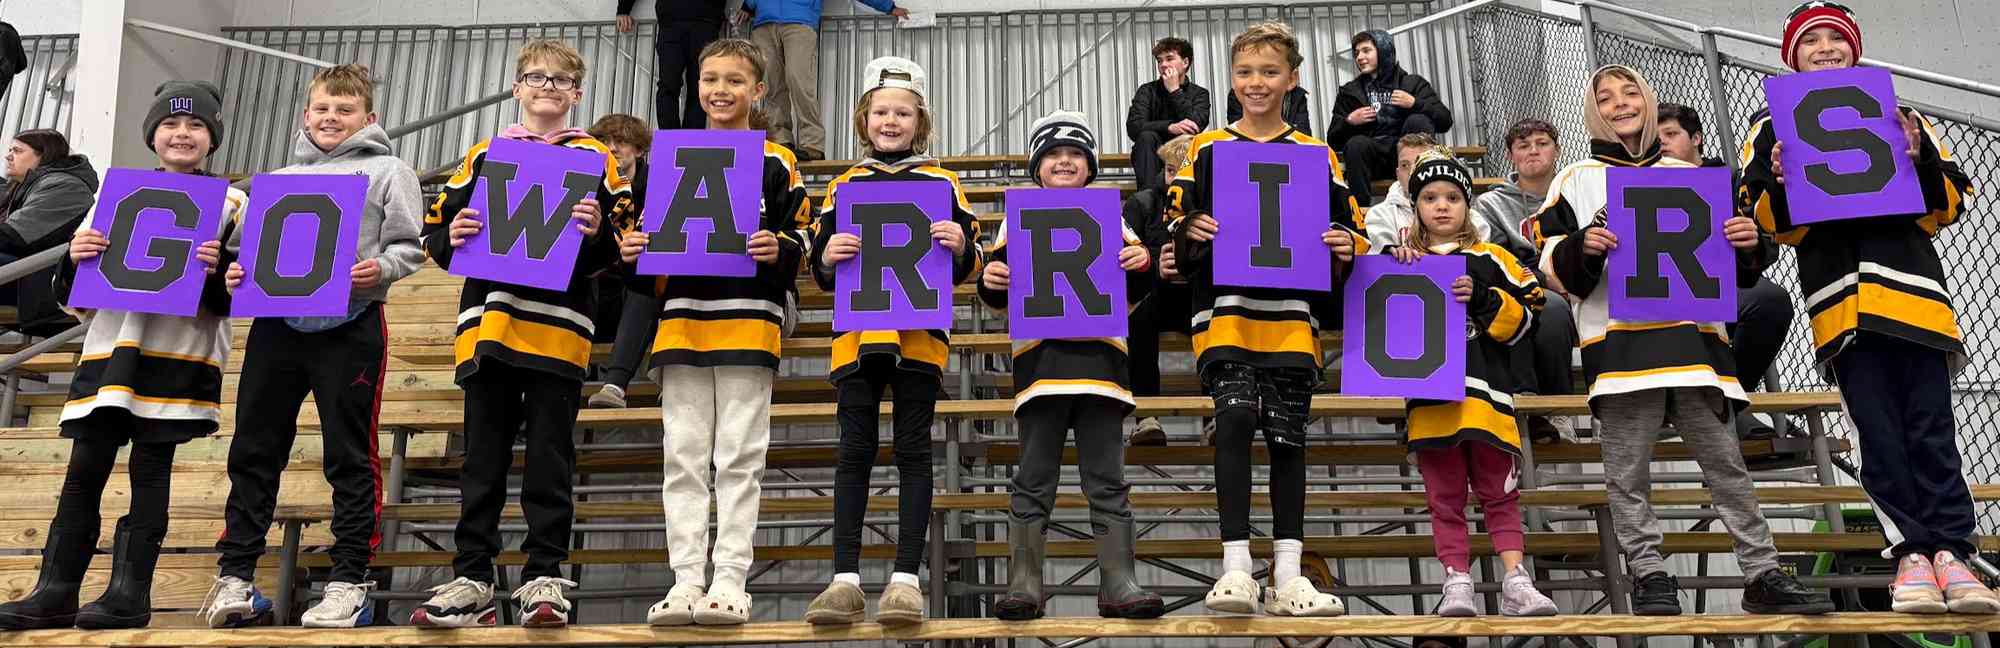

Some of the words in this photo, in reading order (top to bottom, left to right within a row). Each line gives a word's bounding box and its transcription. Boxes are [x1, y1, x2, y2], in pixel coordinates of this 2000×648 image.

[169, 97, 193, 114] W
[1793, 86, 1896, 196] S
[98, 188, 201, 293] G
[253, 194, 341, 296] O
[480, 159, 601, 260] W
[645, 148, 749, 254] A
[1248, 162, 1293, 269] I
[1623, 186, 1720, 300] R
[850, 202, 939, 312] R
[1020, 208, 1112, 319] R
[1364, 274, 1447, 379] O
